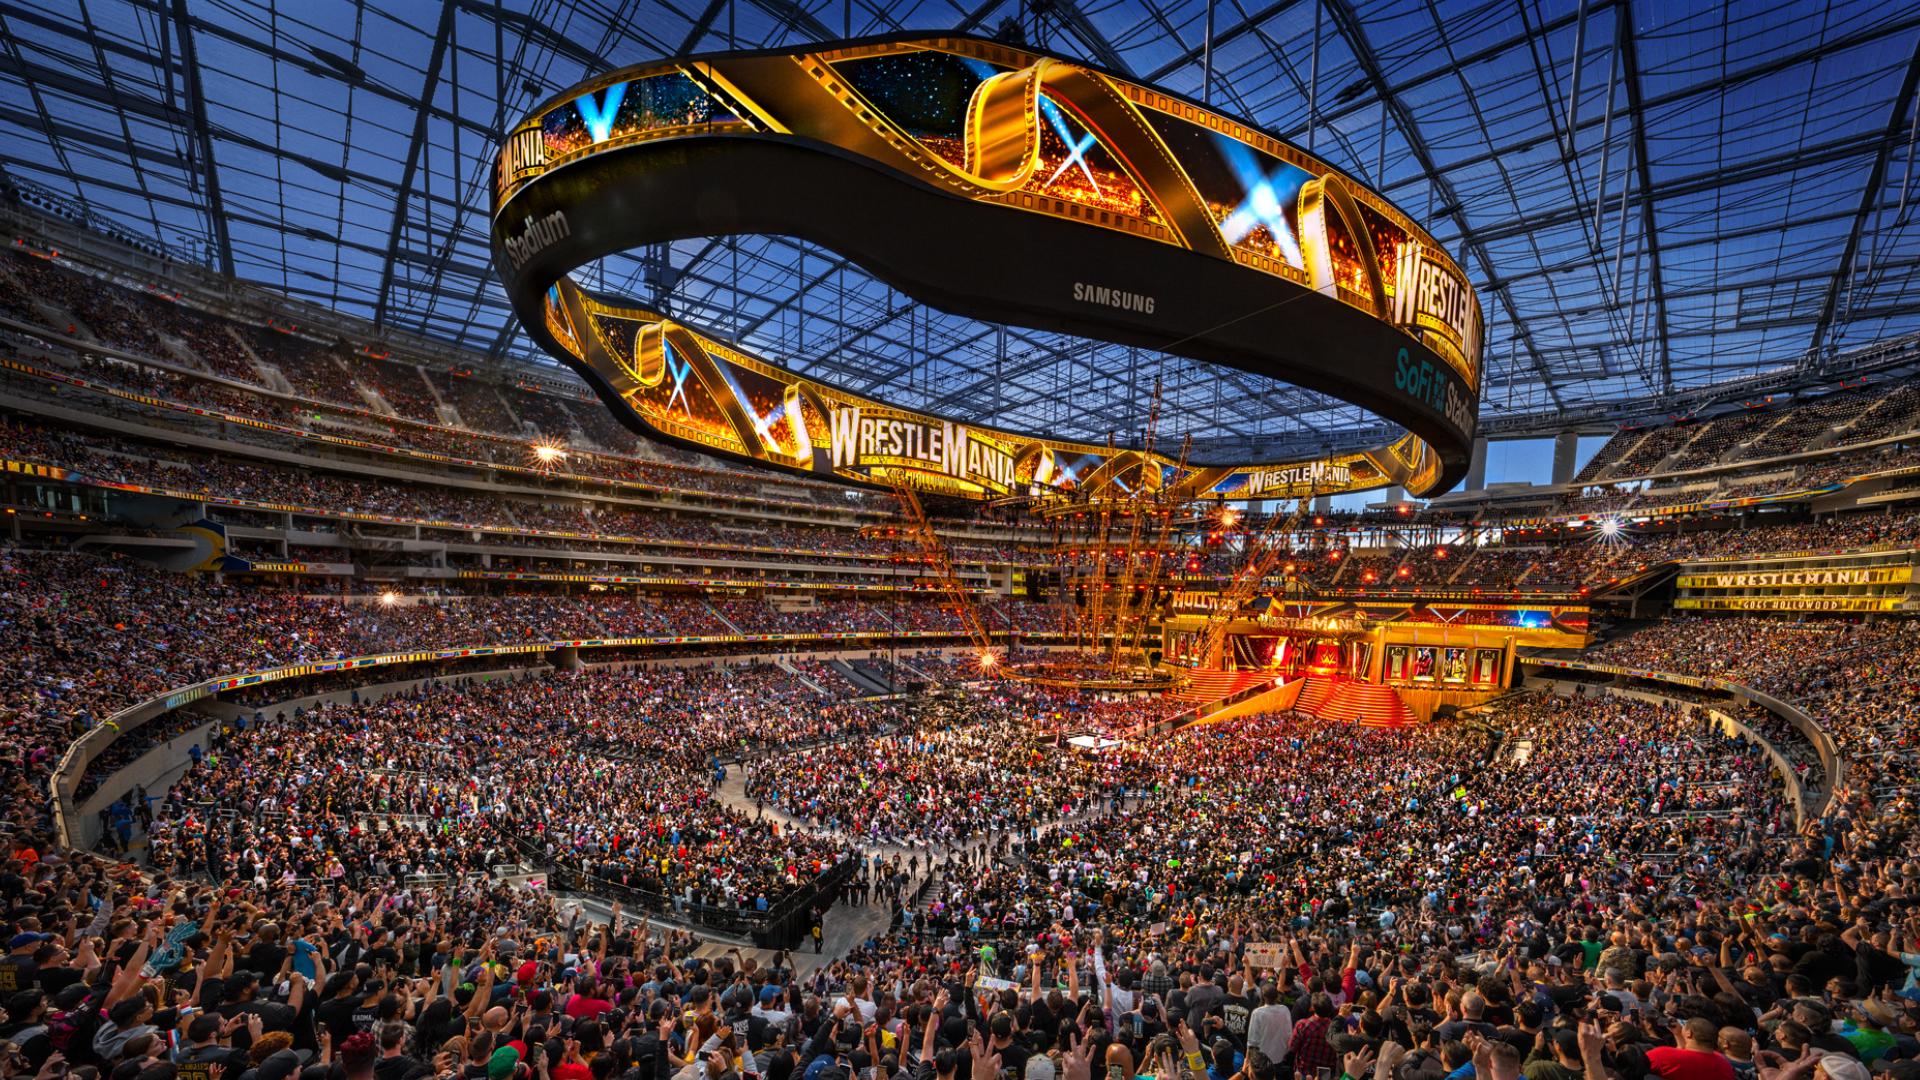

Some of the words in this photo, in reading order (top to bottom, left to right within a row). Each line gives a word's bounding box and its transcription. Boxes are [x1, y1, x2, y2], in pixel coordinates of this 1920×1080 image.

[505, 210, 571, 271] Stadium
[1073, 282, 1155, 314] SAMSUNG
[1395, 348, 1432, 404] SoFi
[831, 407, 1016, 490] WRESTLEMANIA
[1249, 462, 1350, 495] WRESTLEMANIA
[1717, 571, 1870, 587] WRESTLEMANIA
[1772, 601, 1838, 610] HOLLYWOOD
